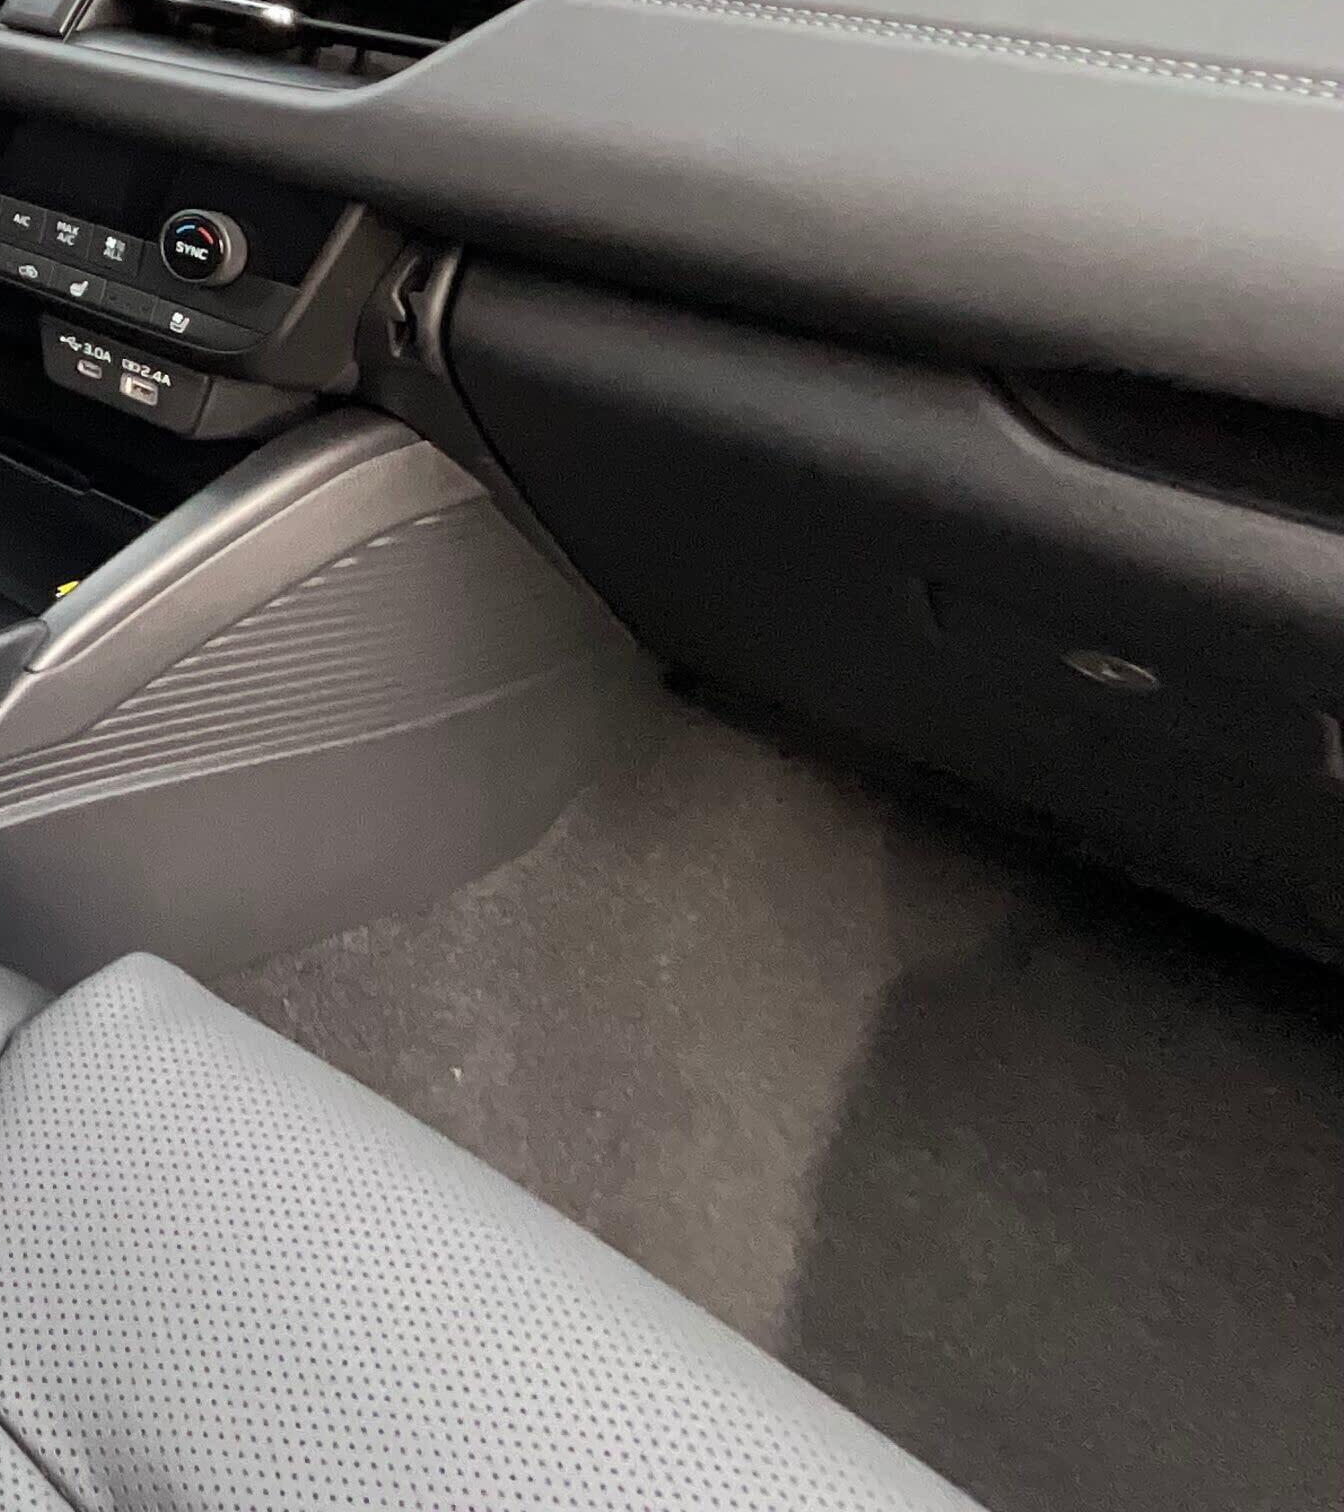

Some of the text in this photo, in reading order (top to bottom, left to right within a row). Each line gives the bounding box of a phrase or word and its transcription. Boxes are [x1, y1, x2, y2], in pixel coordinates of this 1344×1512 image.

[13, 213, 31, 228] A/C
[57, 221, 80, 236] MAX
[175, 240, 209, 261] SYNC
[83, 343, 111, 363] 3.0A
[141, 365, 172, 387] 2.4A
